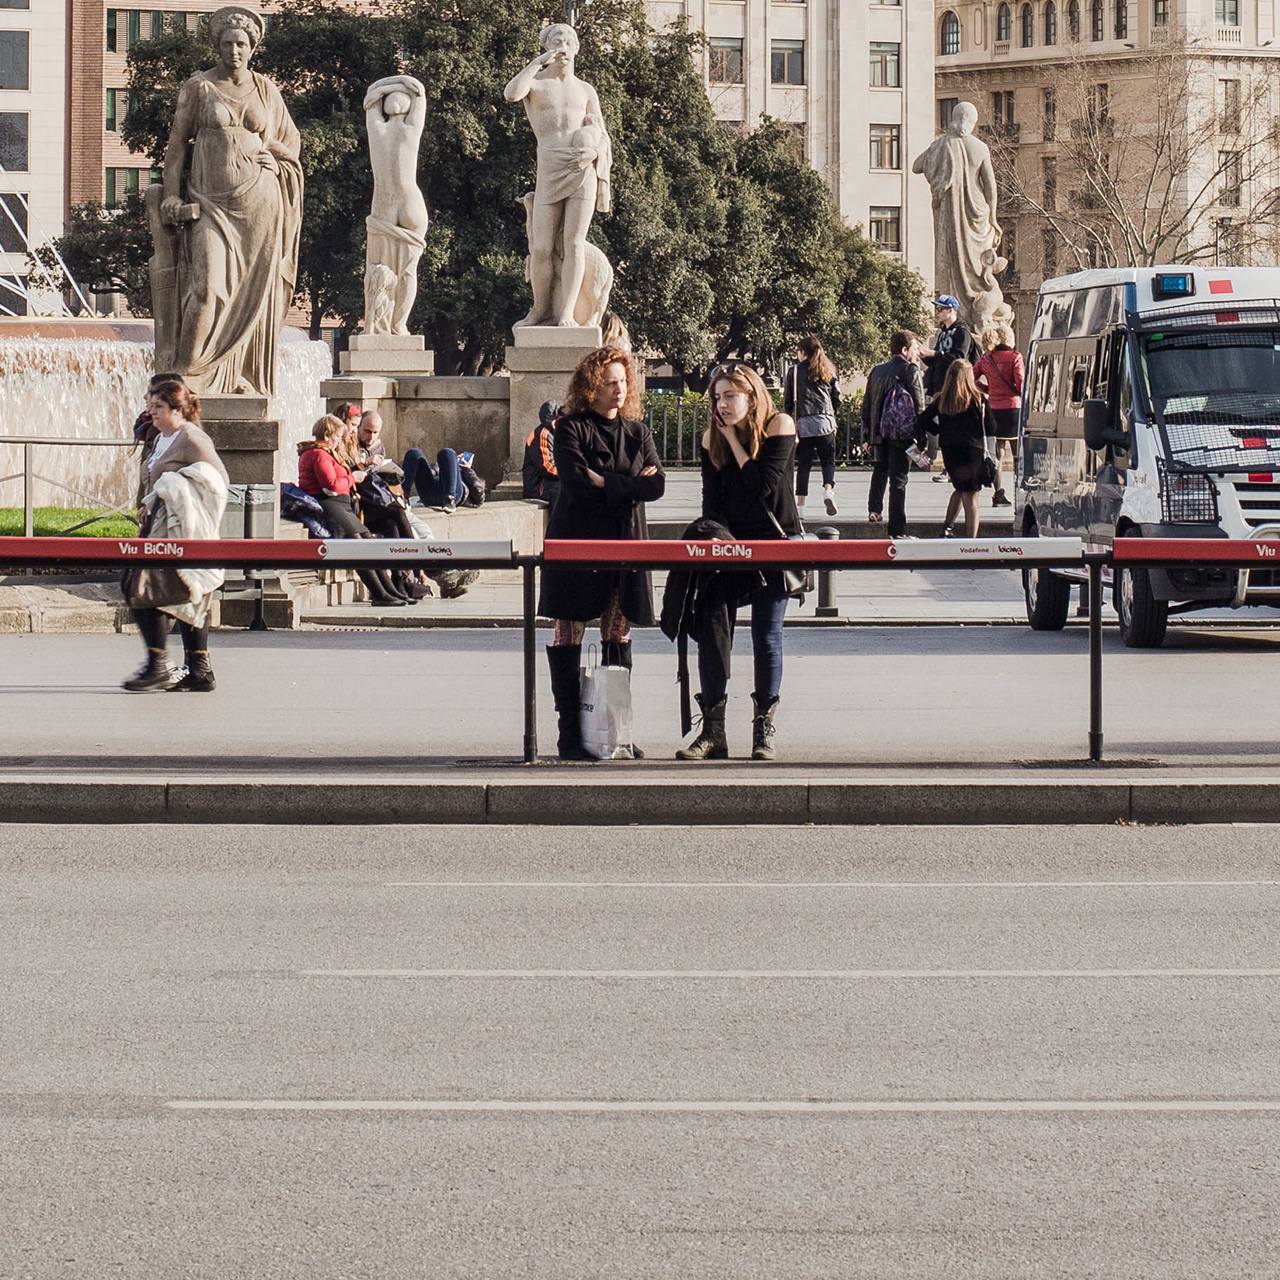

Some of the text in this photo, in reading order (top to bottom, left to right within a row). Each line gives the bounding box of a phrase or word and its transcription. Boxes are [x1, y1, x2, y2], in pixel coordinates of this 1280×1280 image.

[119, 542, 138, 554] Viu
[686, 544, 706, 556] Viu
[1256, 544, 1276, 556] Viu
